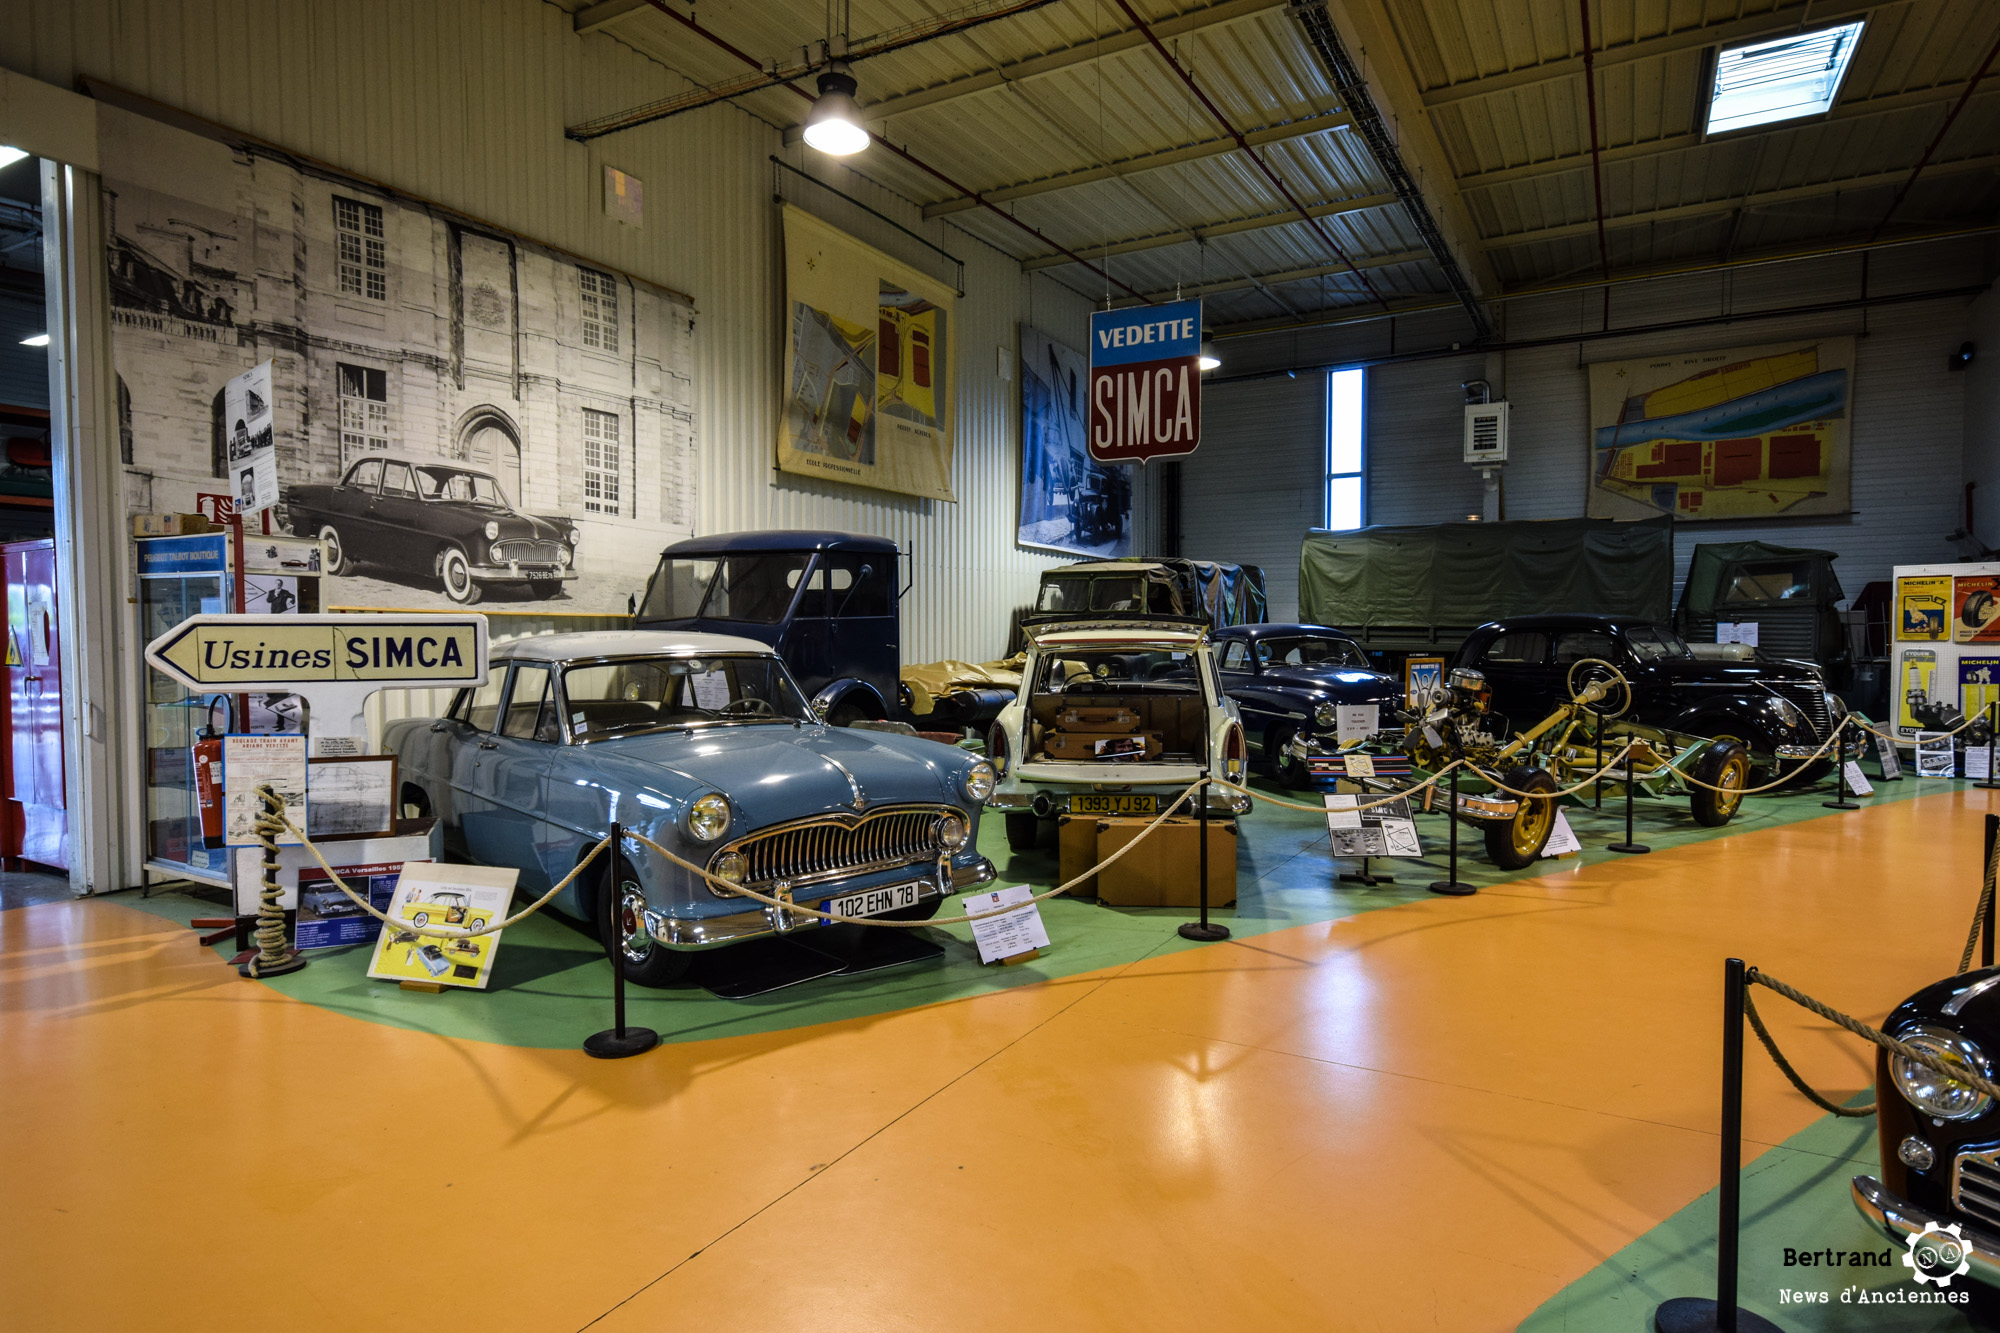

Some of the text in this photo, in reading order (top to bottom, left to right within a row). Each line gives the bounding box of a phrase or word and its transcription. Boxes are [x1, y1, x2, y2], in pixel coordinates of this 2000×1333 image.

[1098, 317, 1194, 349] VEDETTE
[1095, 365, 1194, 449] SIMCA
[806, 458, 862, 476] ECOLE PROFESSIONNELLE
[143, 549, 219, 563] PEUGEOT TALBOT BOUTIQUE
[203, 636, 463, 670] Usines SIMCA
[1077, 796, 1151, 811] 1393 YJ 92
[352, 866, 387, 874] Versailles
[837, 885, 914, 917] 102 EHN 78
